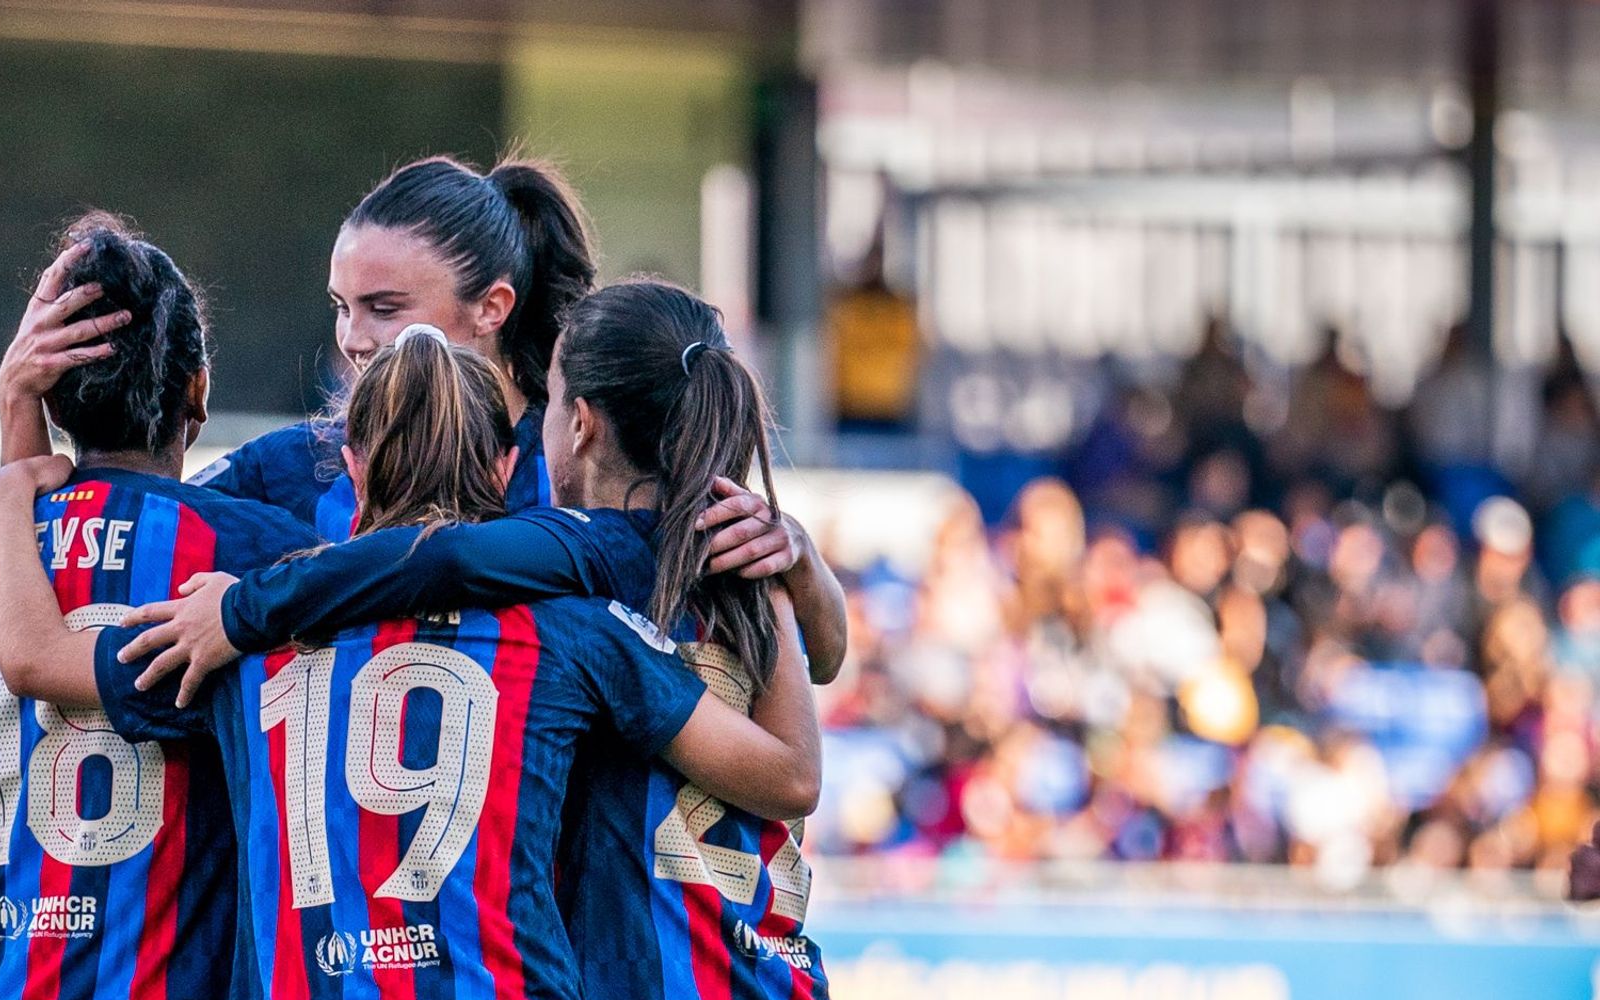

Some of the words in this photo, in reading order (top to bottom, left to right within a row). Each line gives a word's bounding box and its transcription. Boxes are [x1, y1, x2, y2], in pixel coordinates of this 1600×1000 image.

[259, 643, 500, 909] 19
[32, 895, 97, 914] UNHCR
[27, 913, 95, 931] ACNUR
[360, 923, 436, 946] UNHCR
[361, 941, 439, 963] ACNUR
[417, 959, 440, 969] Agency
